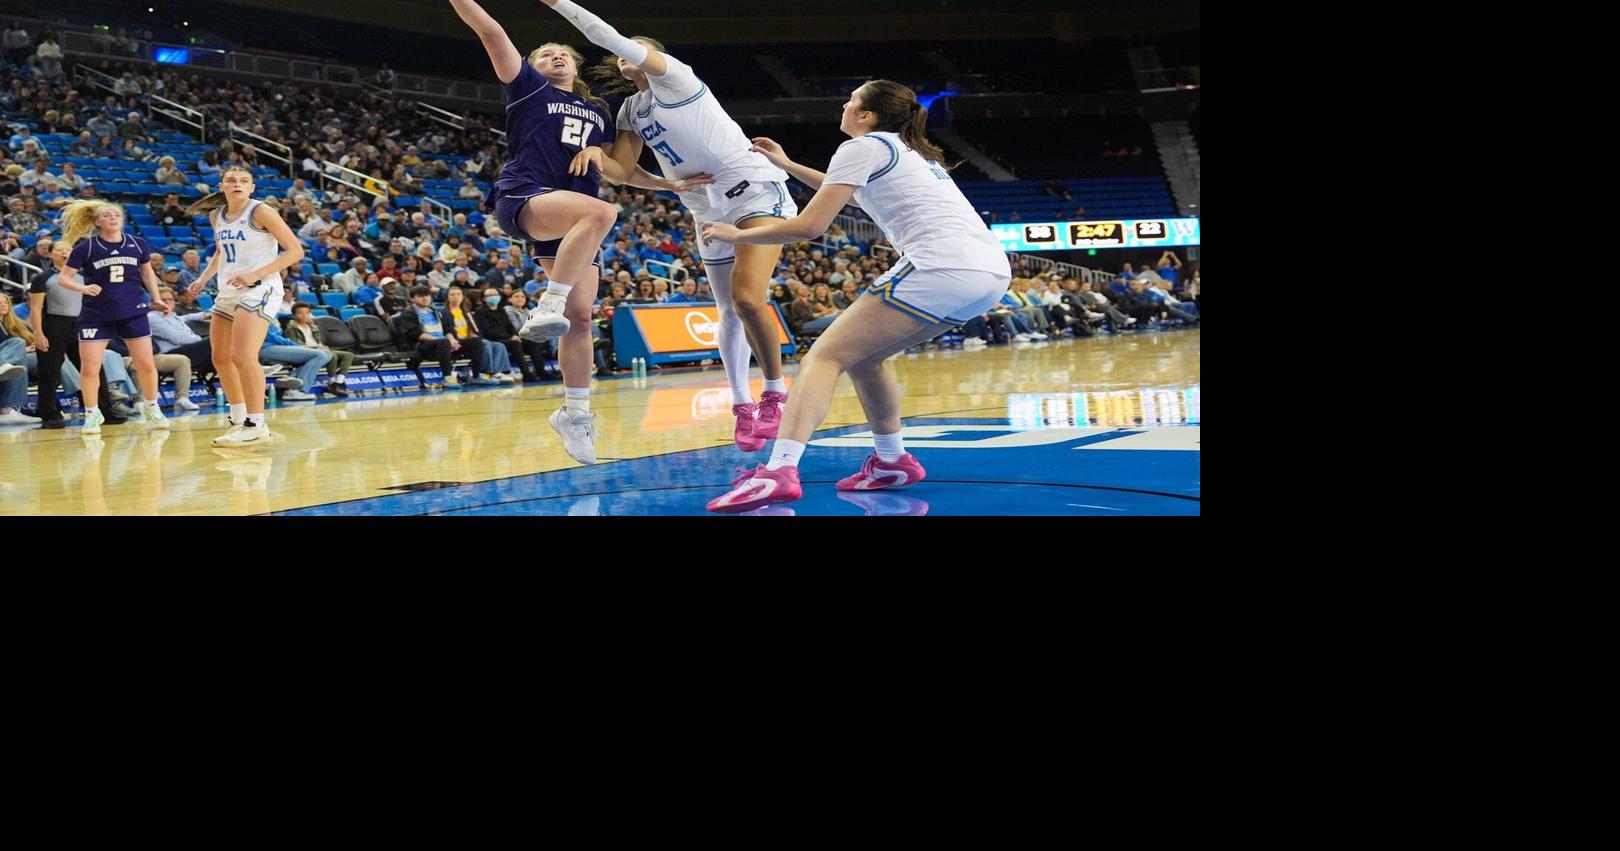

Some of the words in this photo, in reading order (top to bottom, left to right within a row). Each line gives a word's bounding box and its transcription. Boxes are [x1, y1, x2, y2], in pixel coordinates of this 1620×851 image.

[561, 115, 595, 150] 21
[1077, 224, 1116, 238] 2:47
[222, 242, 236, 263] 11
[109, 265, 125, 283] 2
[81, 328, 98, 339] W
